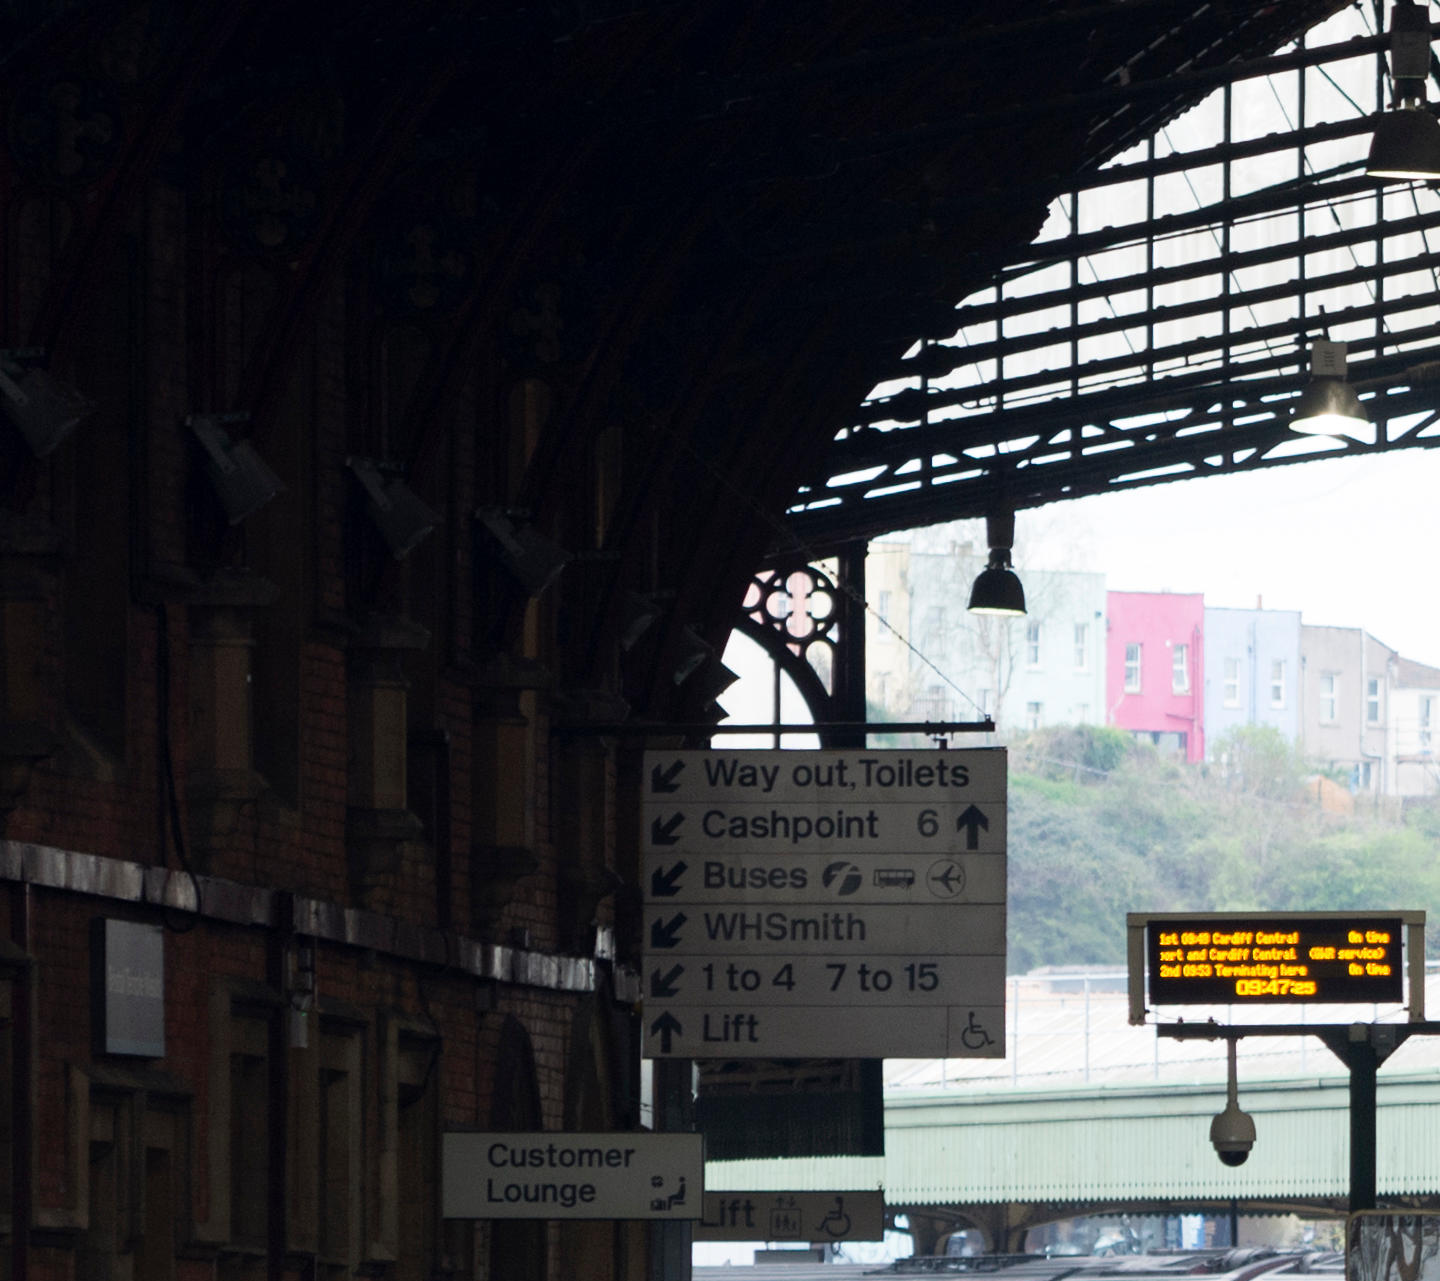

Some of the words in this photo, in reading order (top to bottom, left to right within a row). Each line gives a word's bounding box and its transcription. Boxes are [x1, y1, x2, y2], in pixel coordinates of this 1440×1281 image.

[702, 758, 780, 792] Way
[858, 758, 970, 787] Toilets
[702, 810, 879, 844] Cashpoint
[917, 809, 940, 837] 6
[703, 860, 808, 889] Buses
[703, 912, 866, 941] WHSmith
[1212, 931, 1254, 946] Cardiff
[1256, 931, 1299, 945] Central
[1365, 931, 1391, 944] time
[1187, 948, 1208, 962] and
[1209, 947, 1250, 962] Cardiff
[702, 963, 714, 991] 1
[726, 963, 761, 992] to
[772, 963, 796, 991] 4
[826, 963, 847, 991] 7
[858, 963, 893, 992] to
[904, 963, 939, 992] 15
[1160, 964, 1182, 978] 2nd
[1214, 963, 1279, 979] Terminating
[1280, 963, 1308, 977] here
[1365, 962, 1391, 976] time
[1235, 979, 1317, 996] 09:47:25
[702, 1013, 759, 1043] Lift
[487, 1142, 636, 1168] Customer
[487, 1178, 596, 1208] Lounge
